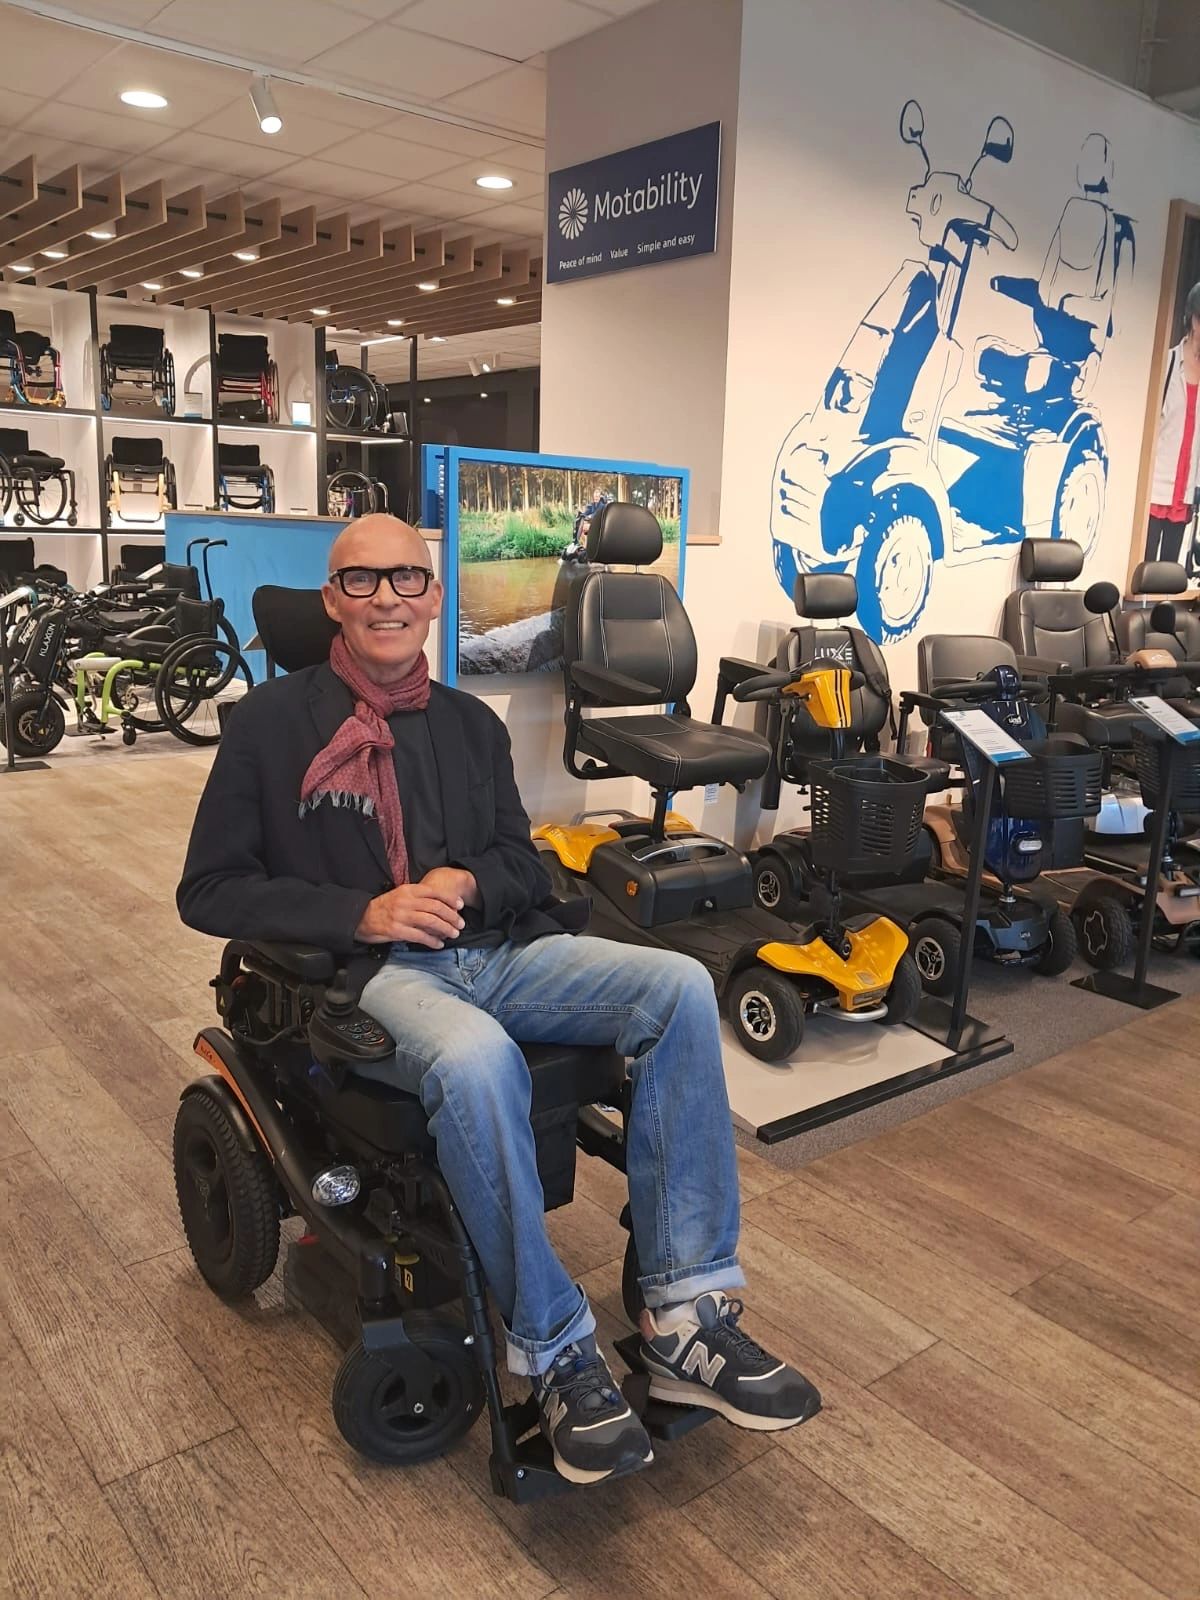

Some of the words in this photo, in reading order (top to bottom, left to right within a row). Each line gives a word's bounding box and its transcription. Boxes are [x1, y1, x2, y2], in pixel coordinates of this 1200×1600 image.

[593, 171, 703, 223] Motability
[559, 260, 577, 270] Peace
[578, 256, 585, 266] of
[586, 252, 602, 264] mind
[610, 247, 629, 259] Value
[637, 240, 661, 254] Simple
[662, 236, 676, 248] and
[678, 234, 695, 245] easy
[39, 622, 56, 657] KLAXON
[682, 1340, 726, 1387] N
